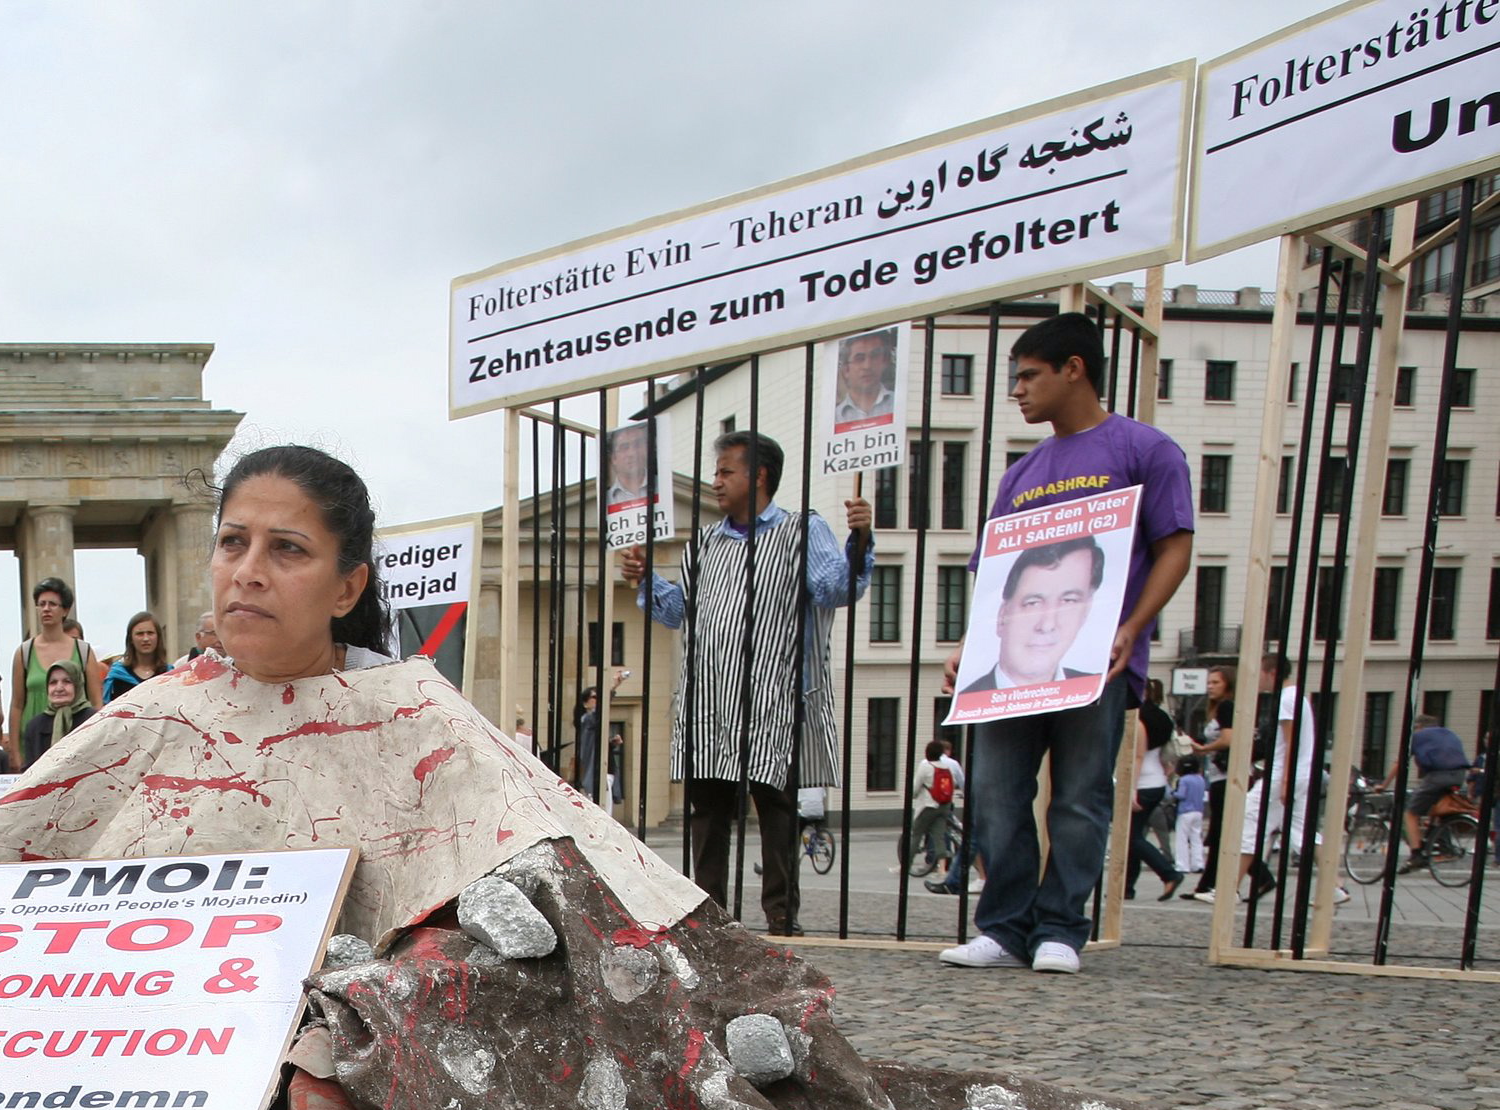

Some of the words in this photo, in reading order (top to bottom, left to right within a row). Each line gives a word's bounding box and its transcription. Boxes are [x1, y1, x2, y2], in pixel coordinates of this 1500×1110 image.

[467, 260, 615, 322] Folterstätte
[624, 238, 692, 278] Evin
[729, 192, 864, 249] Teheran
[468, 307, 698, 384] Zehntausende
[708, 287, 785, 326] zum
[799, 259, 899, 303] Tode
[913, 199, 1121, 285] gefoltert
[823, 445, 899, 475] Kazemi
[826, 437, 856, 457] Ich
[864, 431, 896, 450] bin
[637, 510, 666, 526] bn
[994, 510, 1052, 535] RETTET
[1055, 506, 1082, 521] den
[1087, 494, 1130, 514] Vater
[997, 532, 1024, 551] ALI
[1025, 519, 1083, 544] SAREMI
[1087, 513, 1118, 535] (62)
[12, 859, 270, 900] PMOI:
[11, 901, 110, 917] Opposition
[200, 891, 309, 909] Mojahedin)
[203, 957, 261, 995] &
